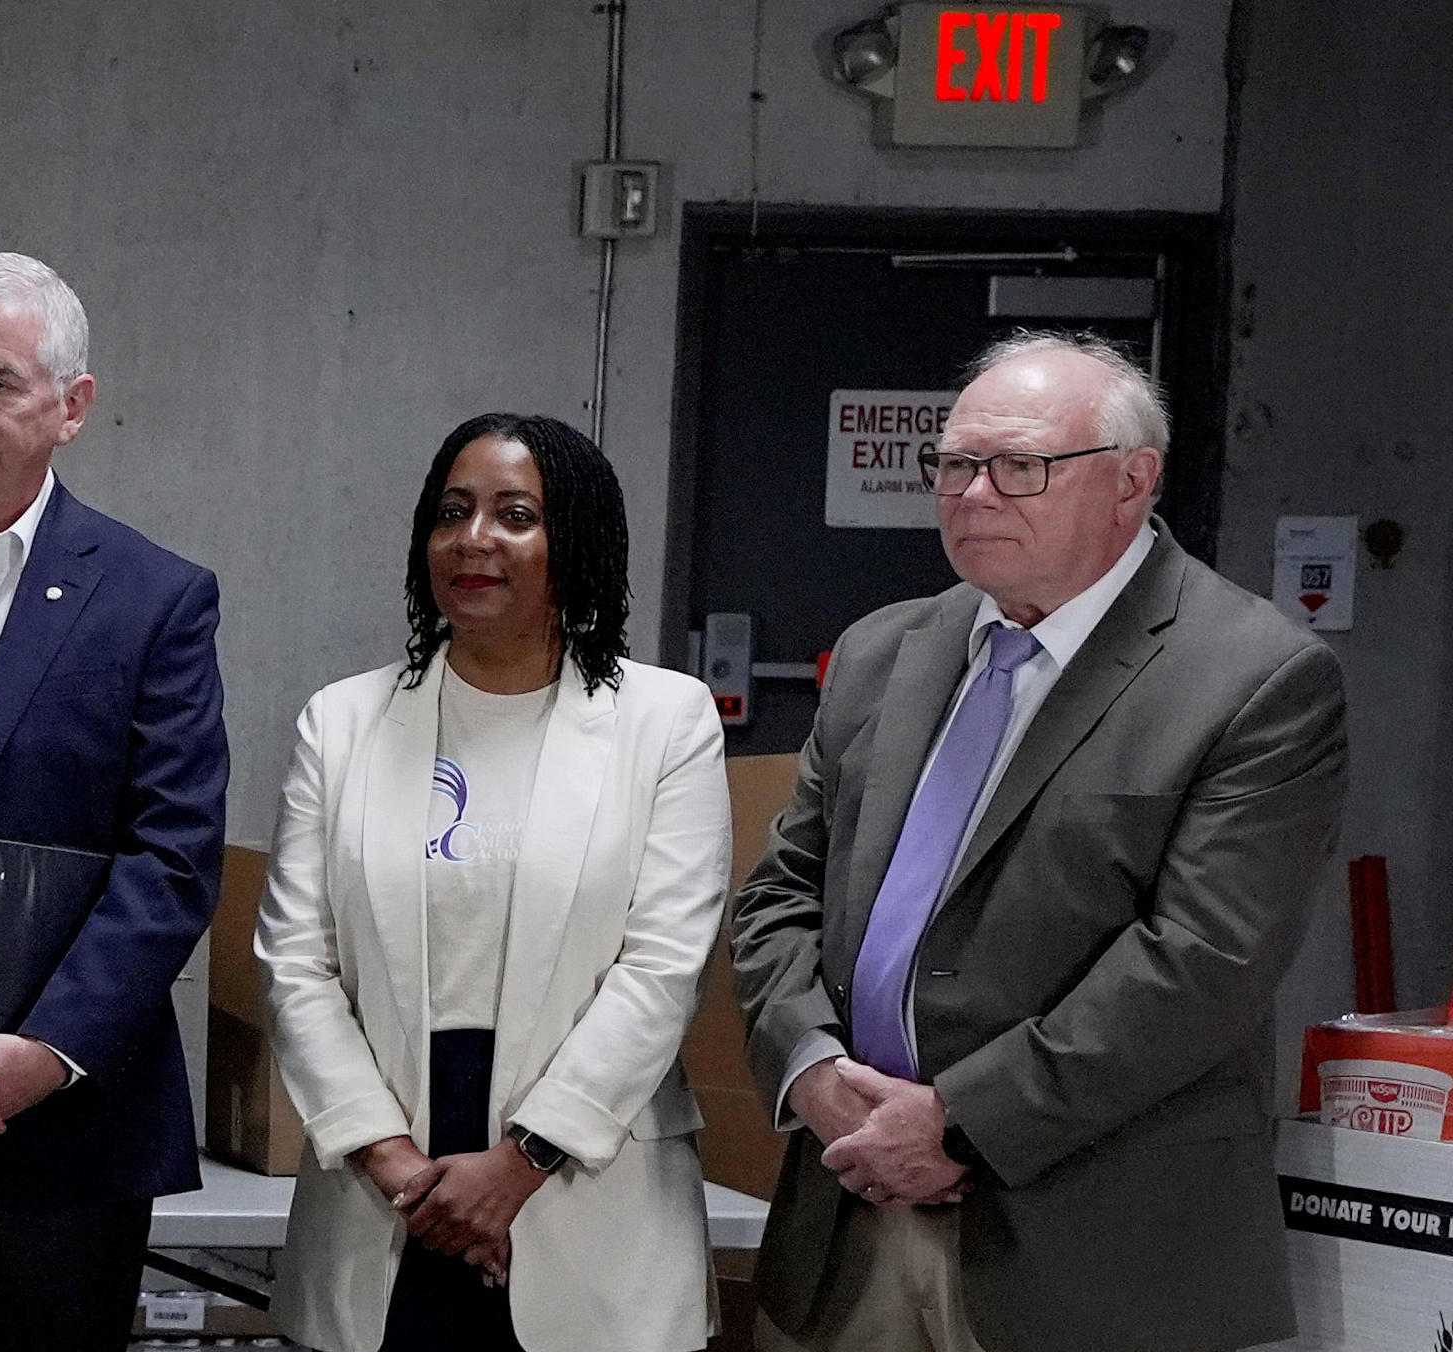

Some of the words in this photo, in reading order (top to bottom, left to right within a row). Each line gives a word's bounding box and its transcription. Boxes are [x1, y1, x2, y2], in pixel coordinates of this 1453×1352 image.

[936, 11, 1061, 103] EXIT
[840, 405, 950, 433] EMERGE
[852, 440, 910, 468] EXIT
[861, 479, 903, 493] ALARM
[1289, 1191, 1372, 1225] DONATE
[1380, 1206, 1441, 1237] YOUR
